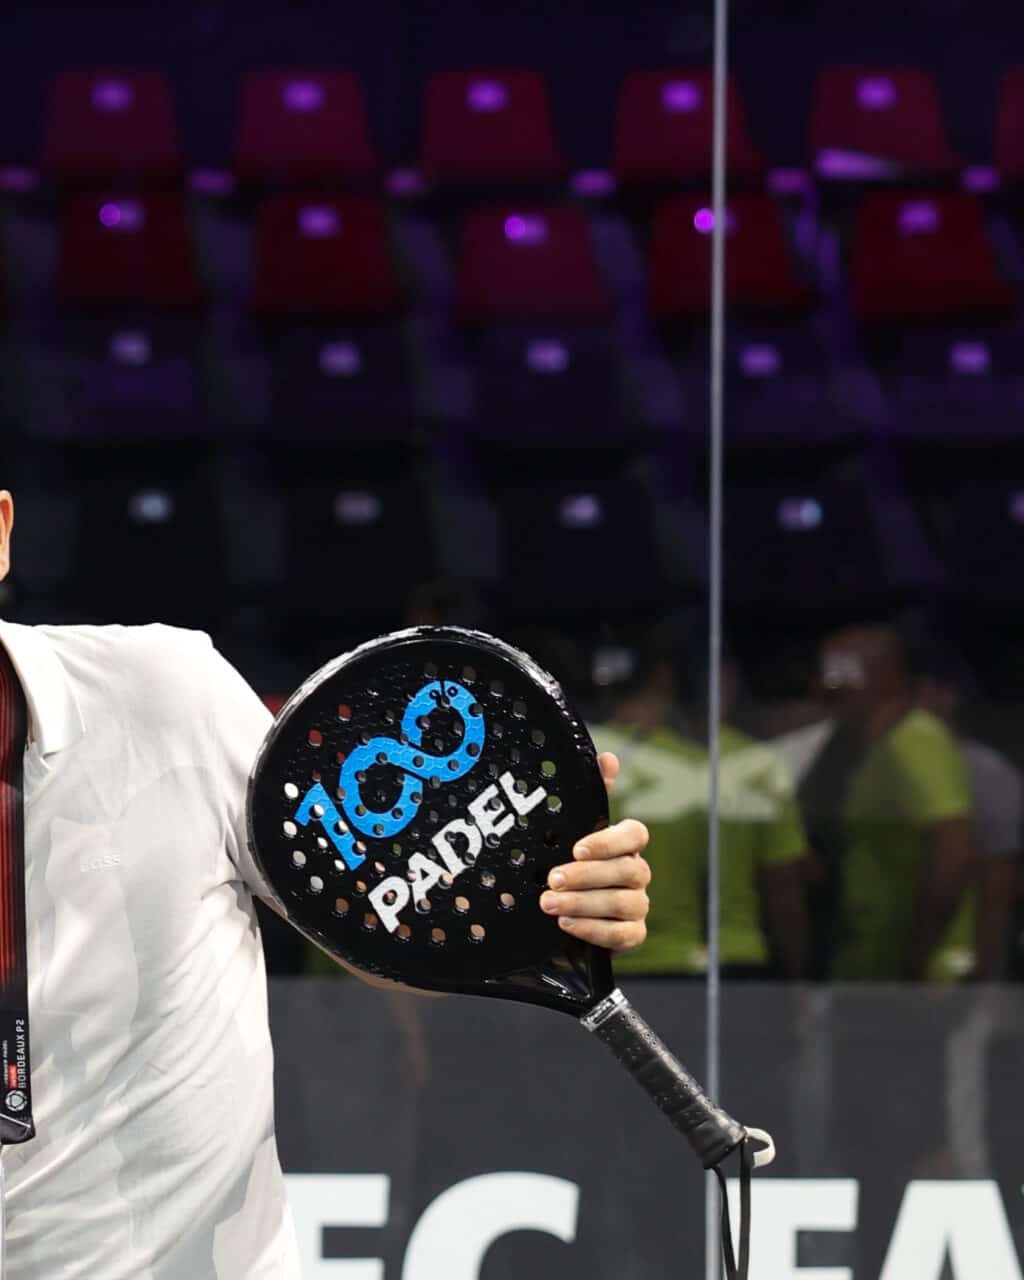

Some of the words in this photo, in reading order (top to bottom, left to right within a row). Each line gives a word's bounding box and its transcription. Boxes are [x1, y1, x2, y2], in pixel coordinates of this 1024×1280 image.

[368, 772, 547, 933] PADEL
[16, 1019, 25, 1032] P2
[16, 1034, 26, 1088] BORDEAUX
